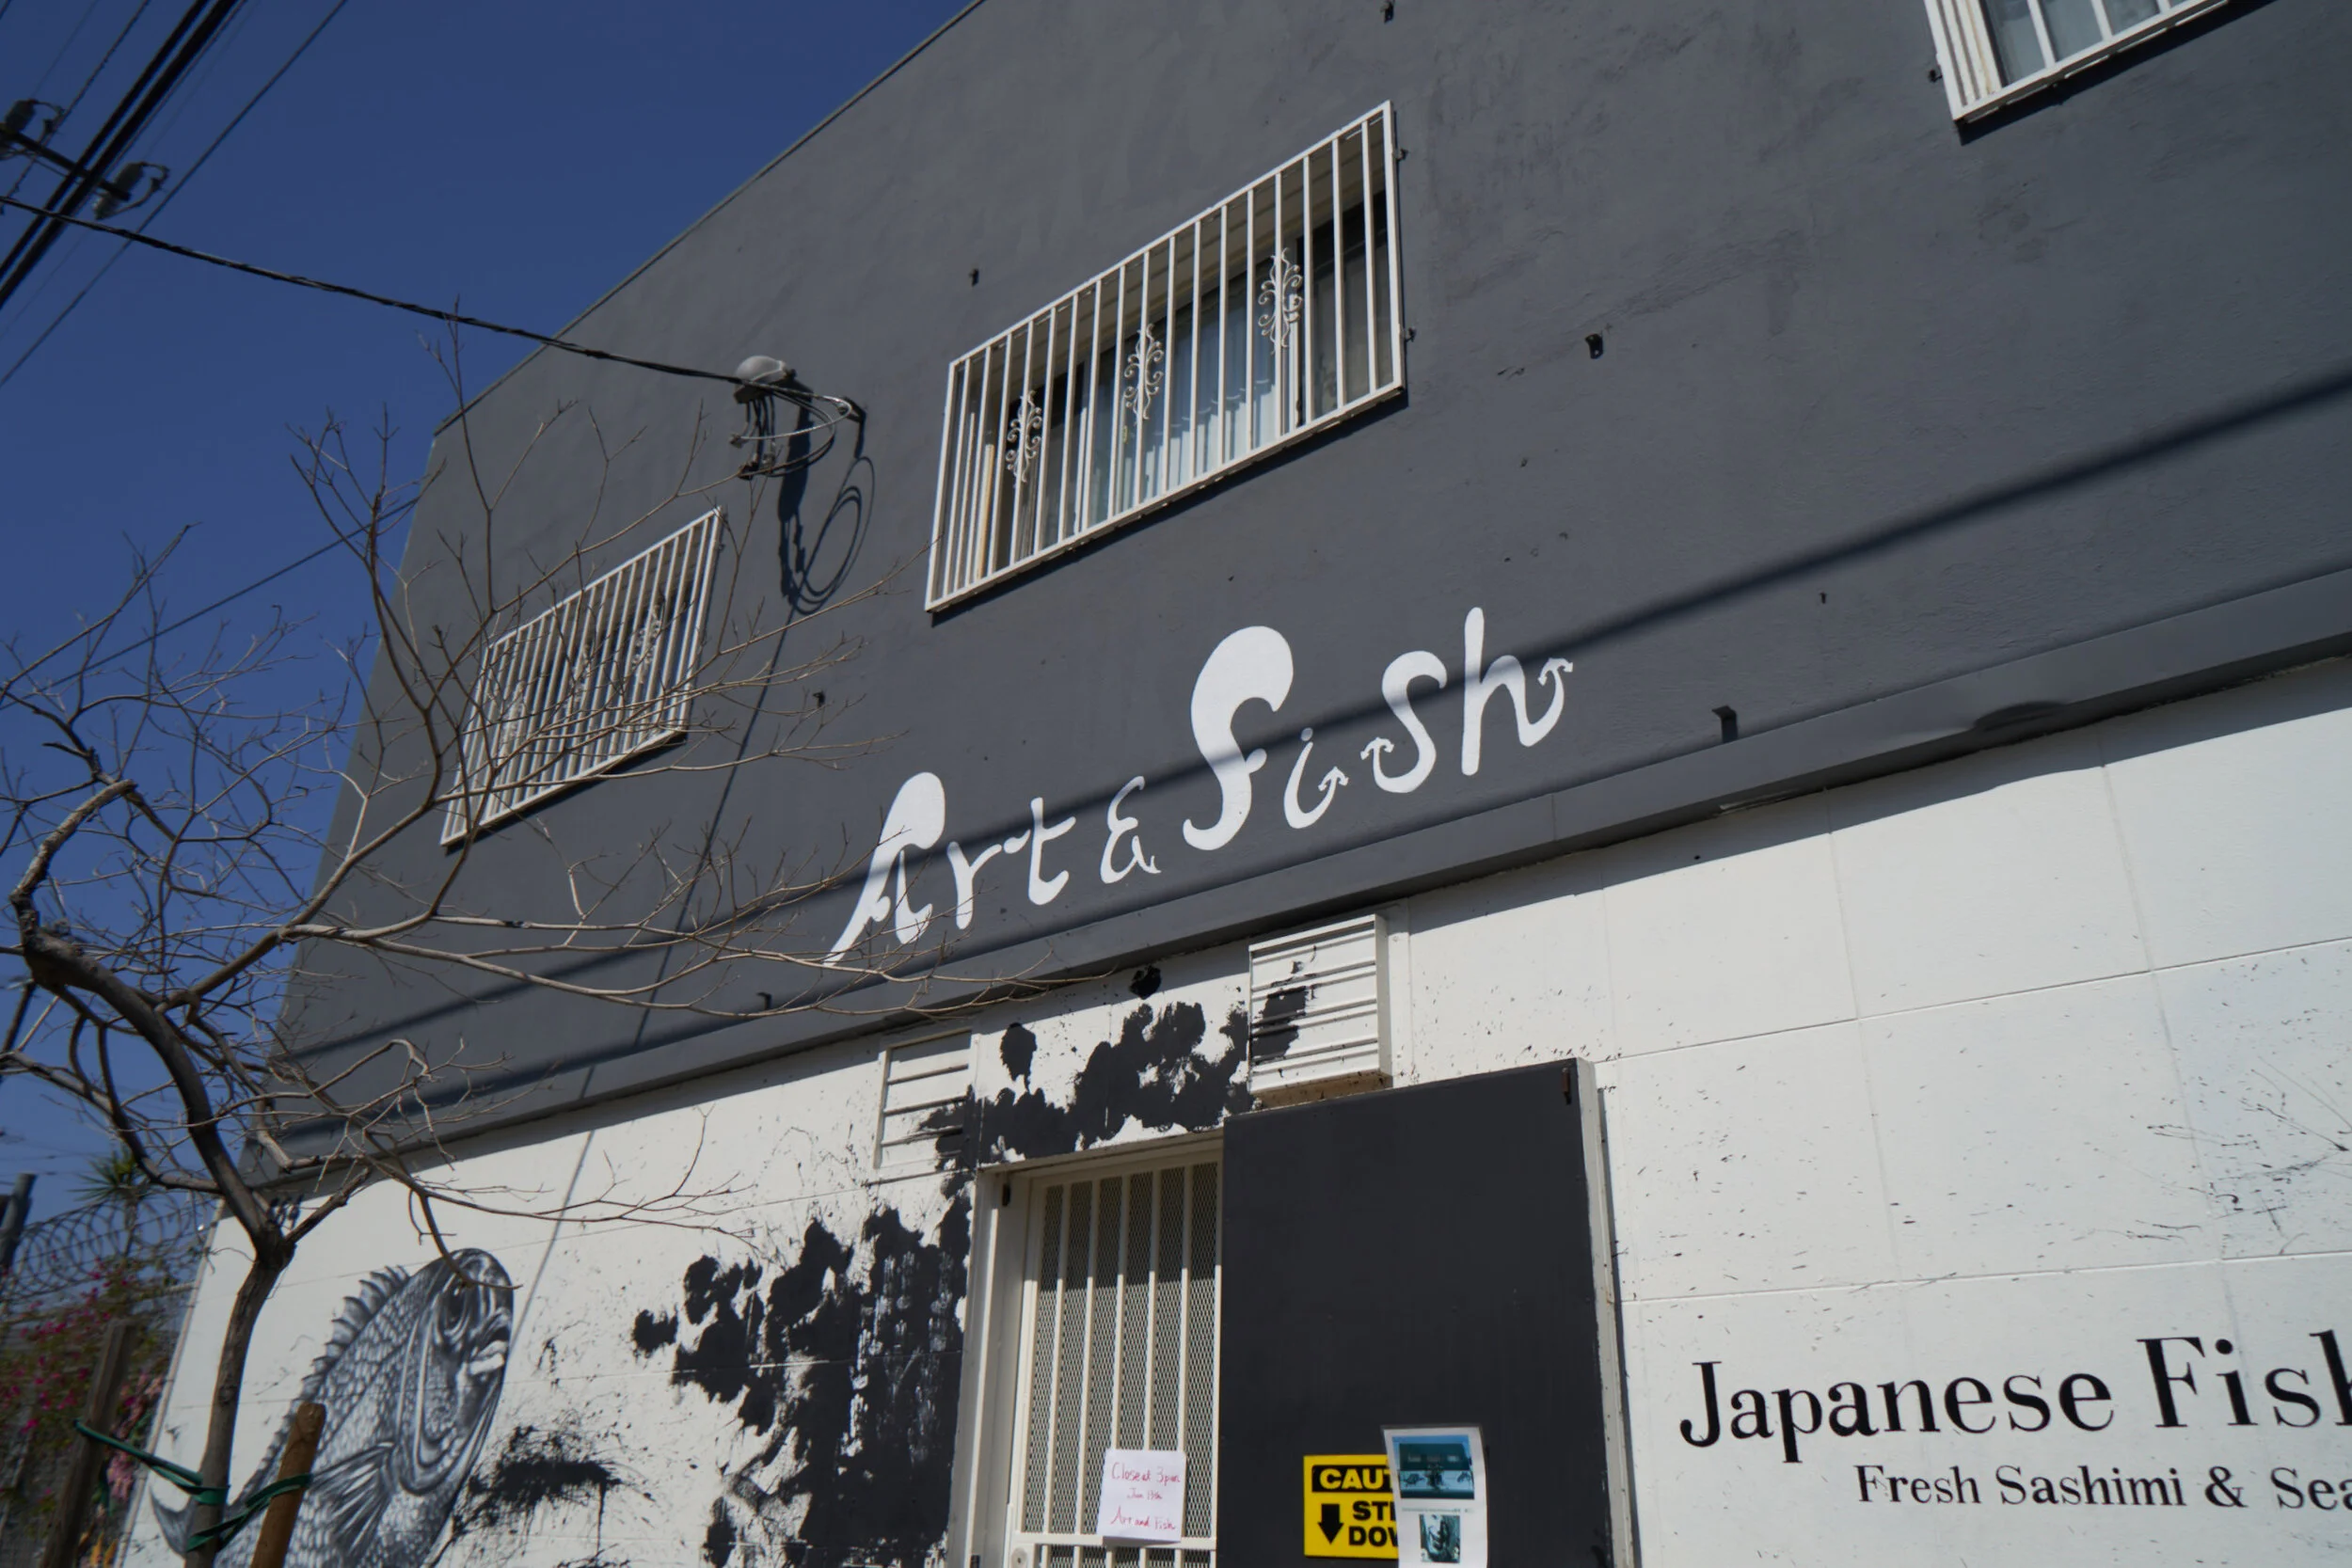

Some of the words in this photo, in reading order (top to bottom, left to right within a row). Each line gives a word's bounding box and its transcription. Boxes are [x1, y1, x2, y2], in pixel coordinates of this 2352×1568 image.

[822, 771, 1076, 967] Art
[1100, 776, 1162, 884] &
[1183, 607, 1574, 851] Fish
[1679, 1360, 2115, 1464] Japanese
[1134, 1515, 1151, 1528] and
[1853, 1465, 1981, 1505] Fresh
[1994, 1464, 2187, 1507] Sashimi
[2204, 1465, 2249, 1509] &
